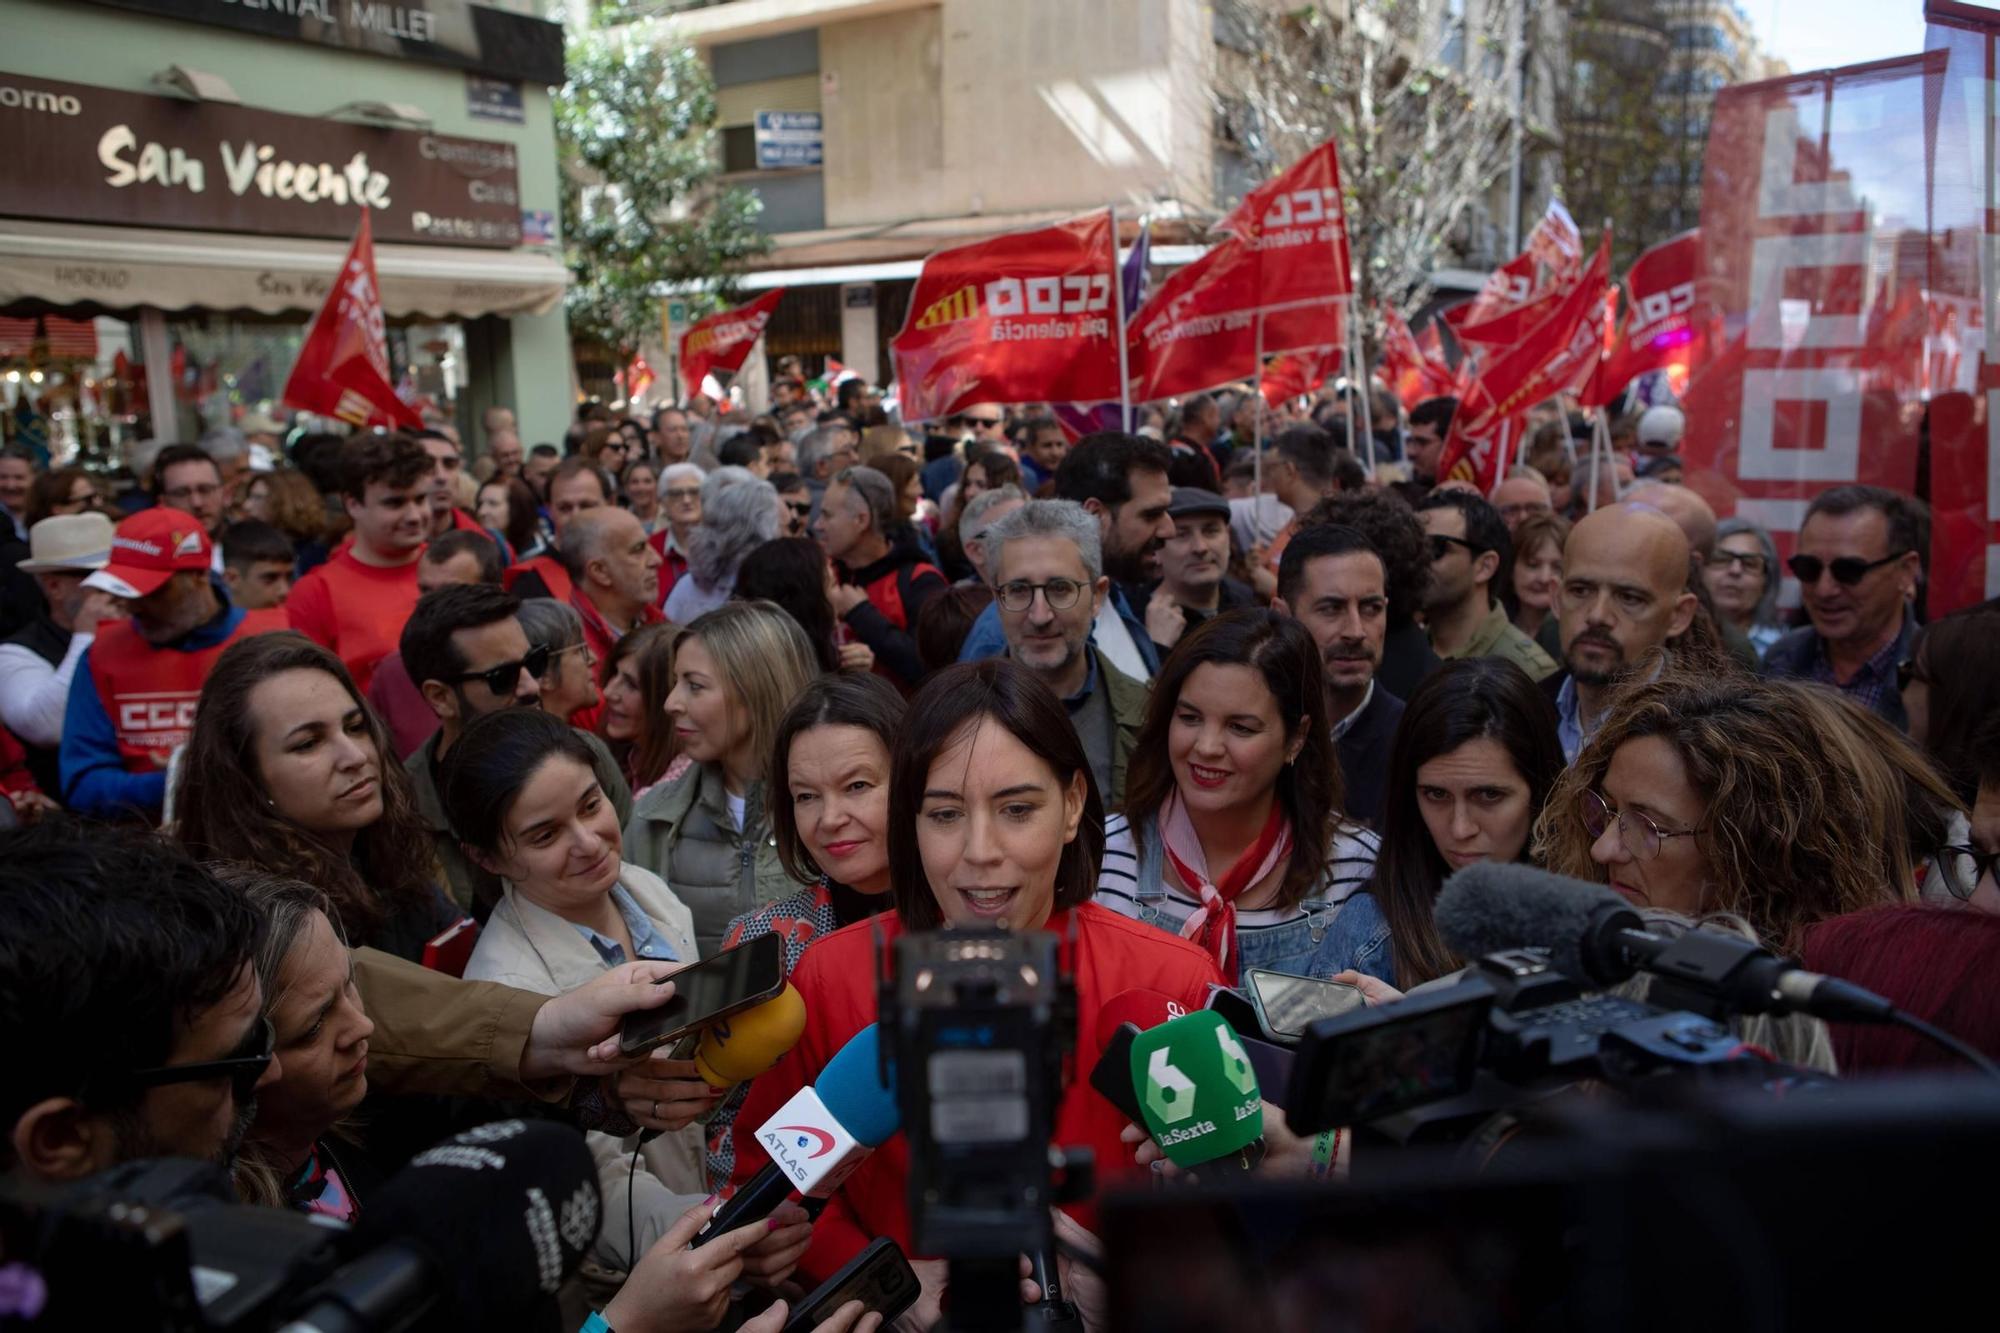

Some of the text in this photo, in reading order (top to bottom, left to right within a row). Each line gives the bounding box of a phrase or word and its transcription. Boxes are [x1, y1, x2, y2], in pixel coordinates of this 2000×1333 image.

[352, 2, 436, 41] MILLET
[97, 124, 391, 209] San Vicente
[1158, 1120, 1216, 1147] laSexta
[764, 1132, 808, 1181] ATLAS
